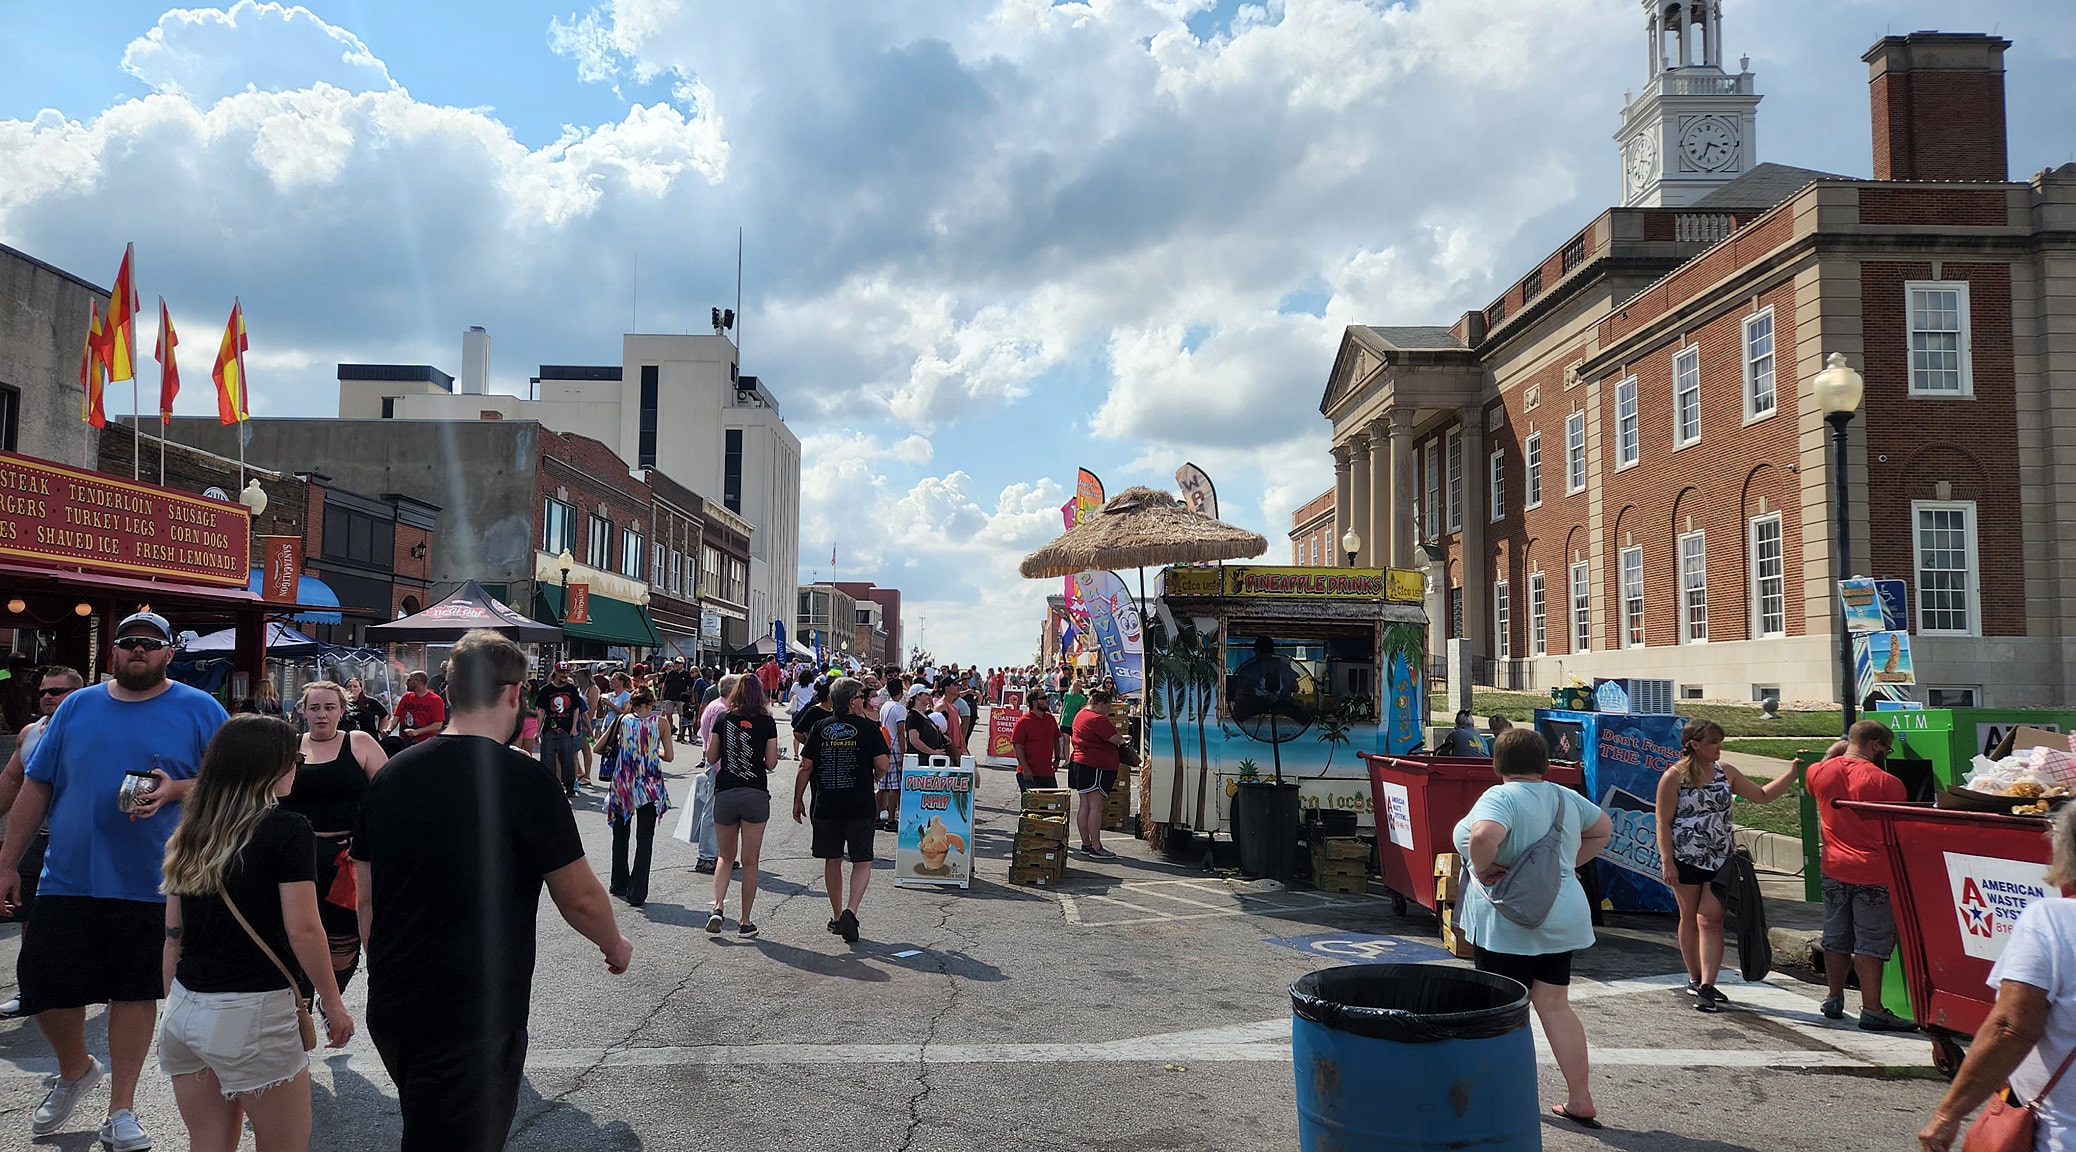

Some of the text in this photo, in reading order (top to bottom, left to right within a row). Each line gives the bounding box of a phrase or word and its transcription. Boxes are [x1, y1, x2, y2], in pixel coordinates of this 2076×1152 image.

[0, 469, 217, 528] STEAK TENDERLOIN SAUSAGE
[65, 506, 120, 531] TURKEY
[125, 517, 155, 537] LEGS
[170, 525, 200, 544] CORN
[203, 531, 228, 549] DOGS
[37, 525, 93, 550] SHAVED
[98, 536, 120, 555] ICE
[136, 542, 175, 562] FRESH
[179, 549, 237, 571] LEMONADE
[1246, 575, 1383, 595] PINEAPPLE DRINKS
[1891, 715, 1928, 729] ATM
[1602, 728, 1639, 748] Don't
[1599, 743, 1641, 766] THE
[905, 775, 969, 791] PINEAPPLE
[921, 794, 950, 810] WHIP
[1982, 879, 2044, 898] AMERICAN
[1987, 893, 2027, 909] WASTE
